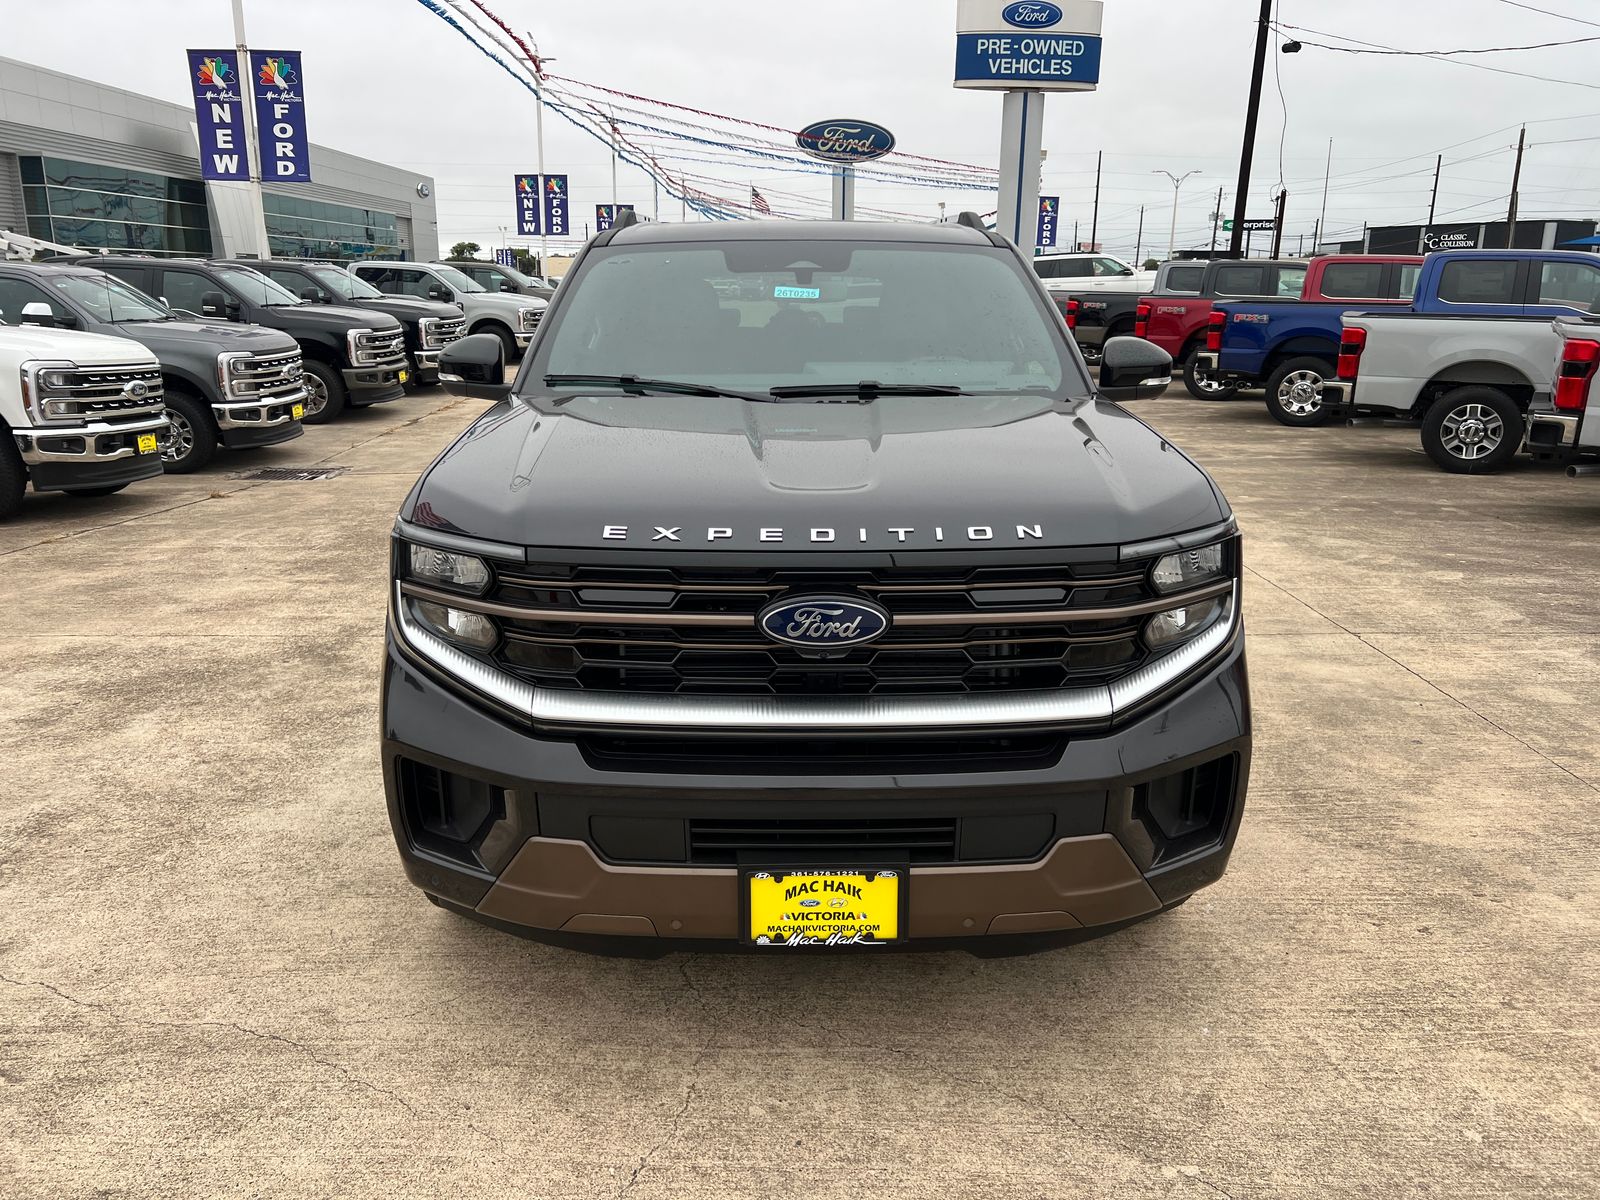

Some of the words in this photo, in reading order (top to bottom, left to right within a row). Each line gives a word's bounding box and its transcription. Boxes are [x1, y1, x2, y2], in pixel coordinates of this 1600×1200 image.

[1015, 4, 1050, 22] Ford
[988, 58, 1073, 75] VEHICLES
[211, 103, 239, 174] NEW
[272, 103, 296, 176] FORD
[817, 126, 876, 152] Ford
[522, 198, 536, 233] NEW
[551, 199, 563, 234] FORD
[1042, 216, 1052, 245] FORD
[1439, 240, 1475, 248] COLLISION
[602, 524, 1044, 543] EXPEDITION
[786, 607, 863, 639] Ford
[785, 880, 819, 902] MAC
[823, 880, 863, 900] HAIK
[791, 912, 856, 921] VICTORIA
[785, 932, 819, 947] Mac
[825, 931, 864, 946] Haik
